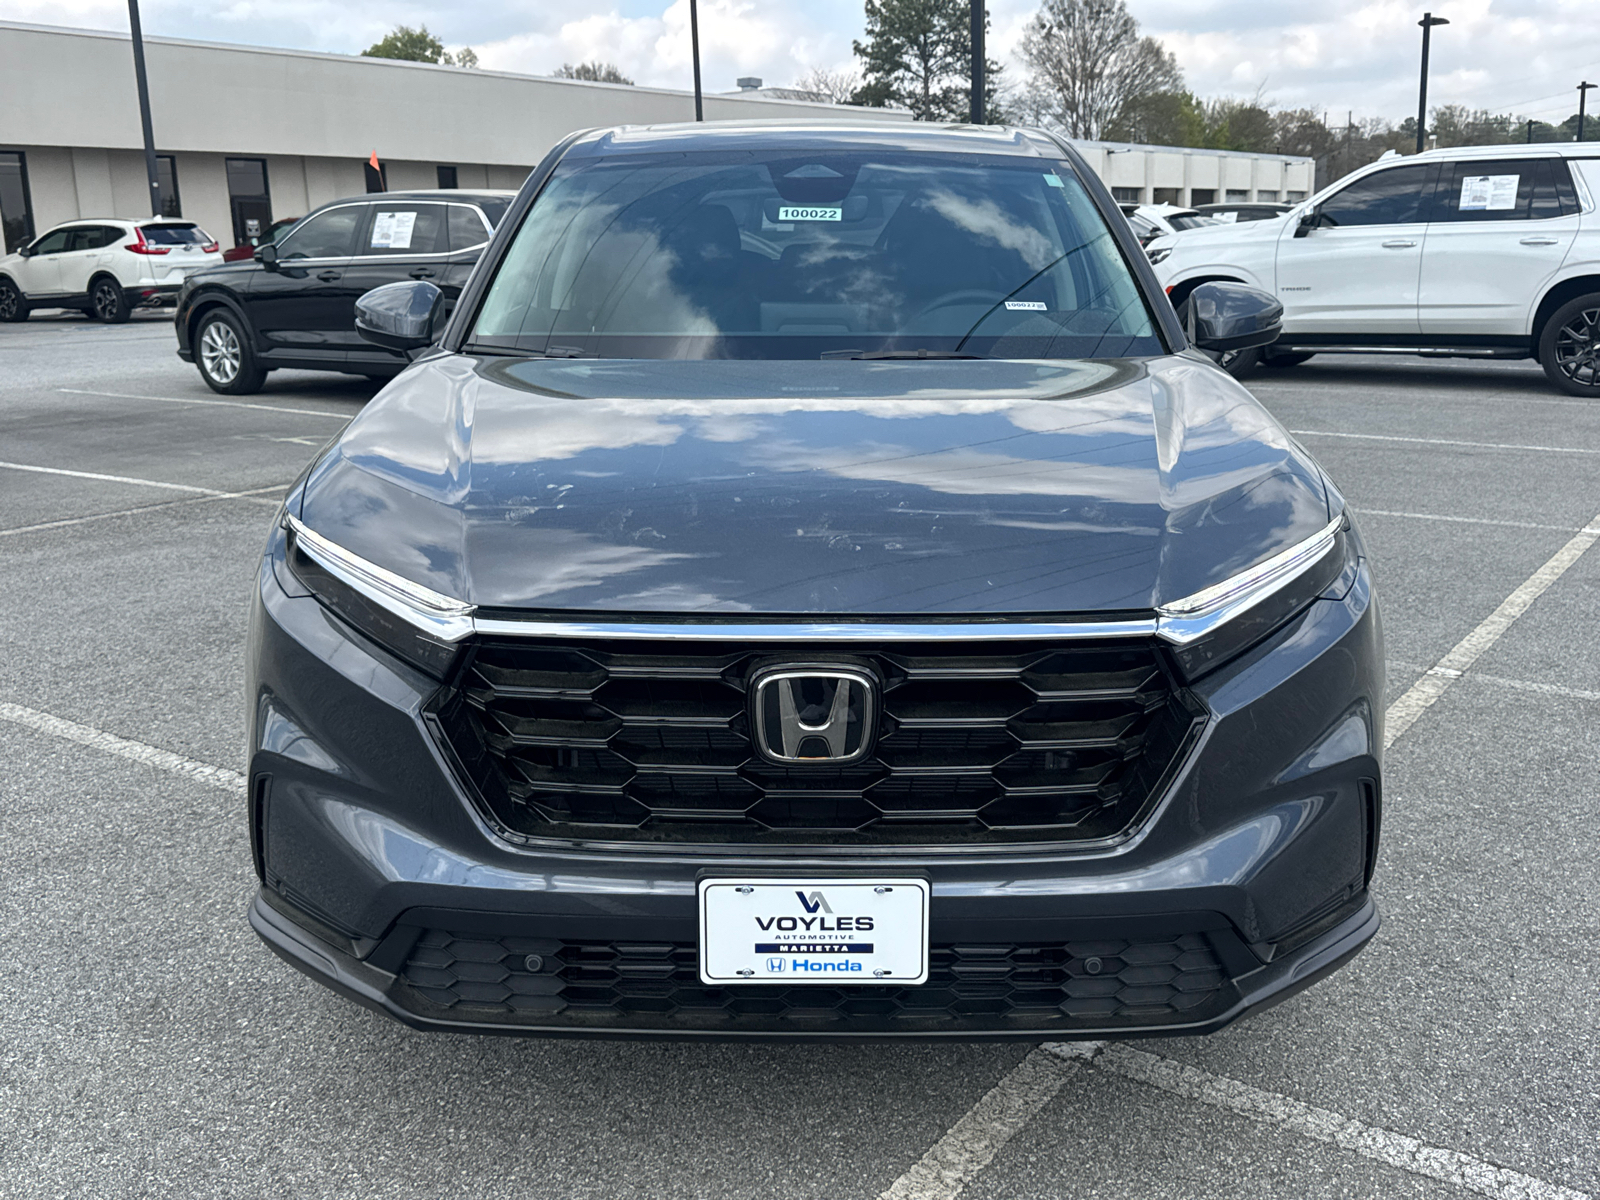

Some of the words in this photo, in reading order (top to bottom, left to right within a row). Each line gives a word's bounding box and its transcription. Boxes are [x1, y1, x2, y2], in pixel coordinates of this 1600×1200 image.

[782, 209, 838, 219] 100022
[754, 916, 874, 931] VOYLES
[792, 959, 862, 972] Honda
